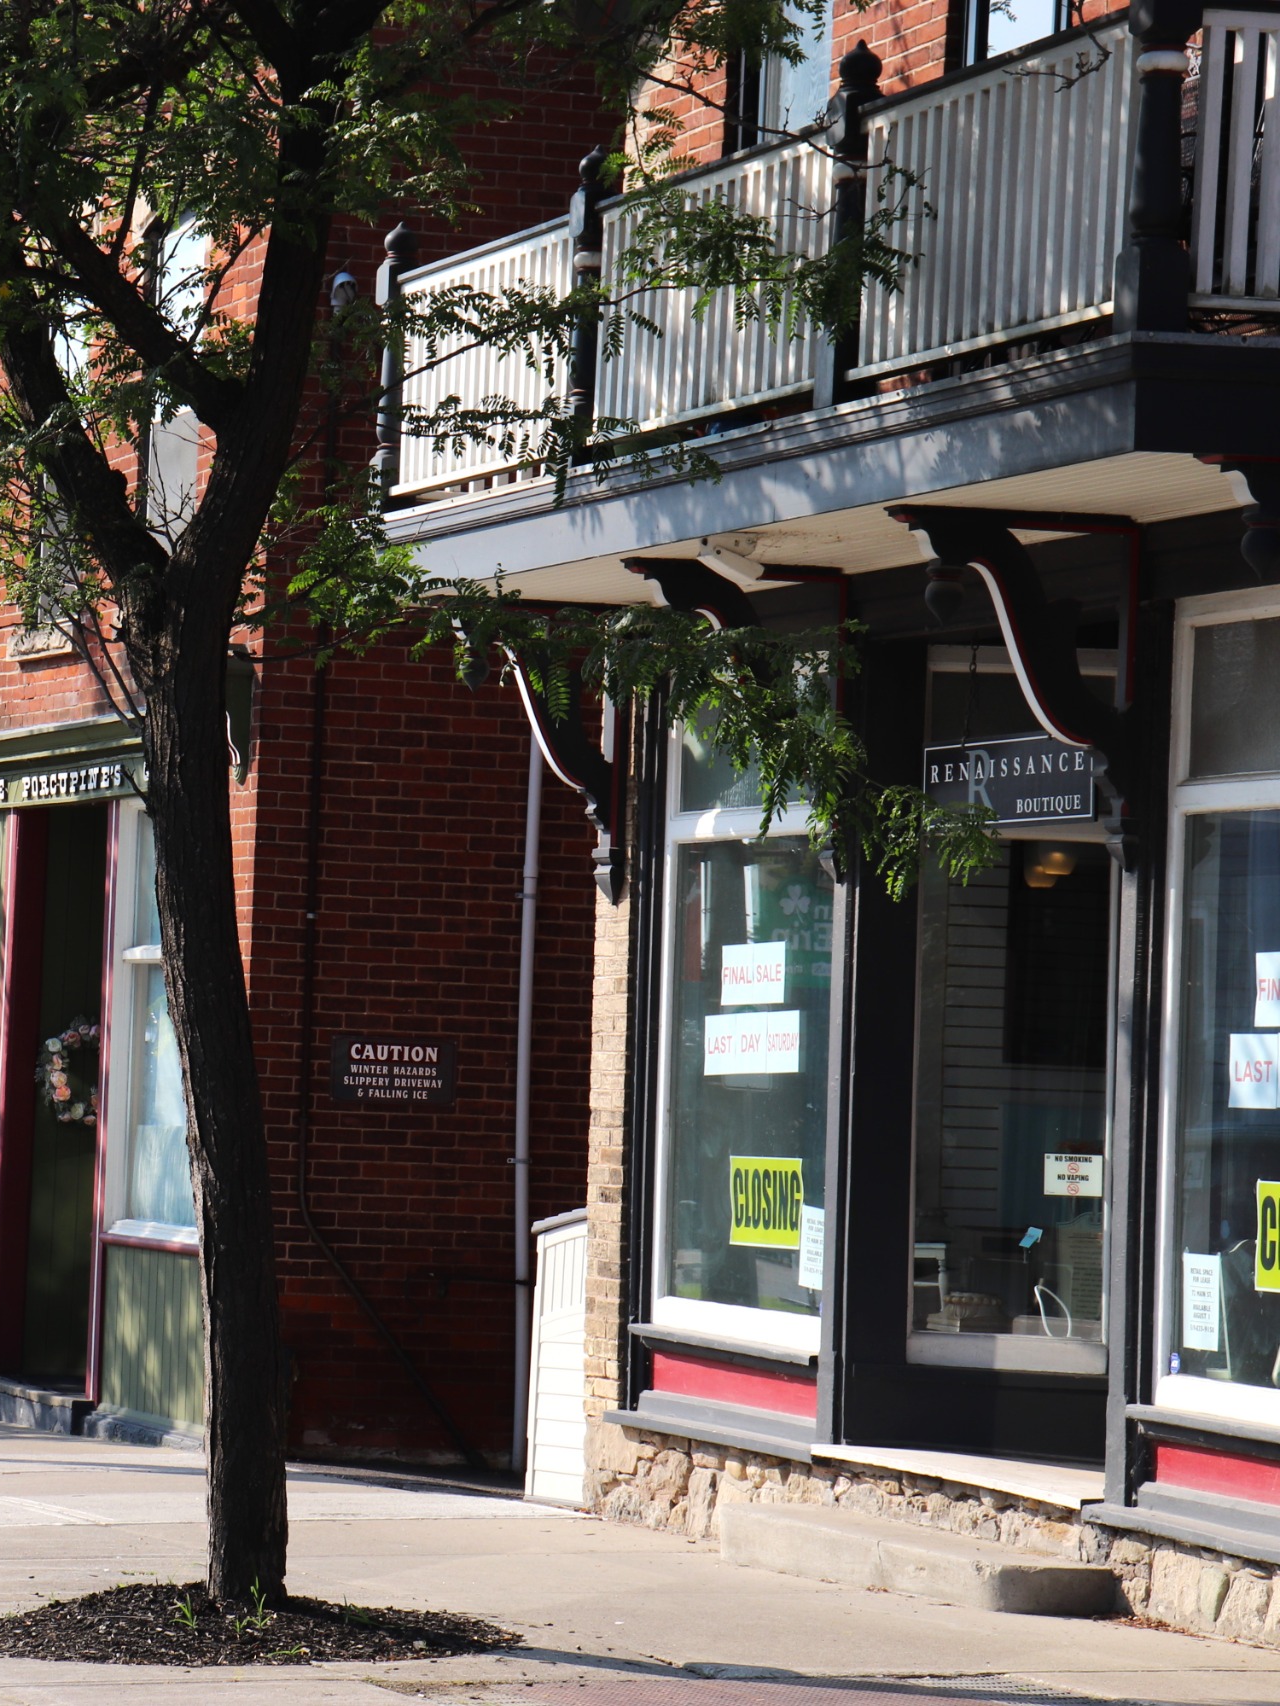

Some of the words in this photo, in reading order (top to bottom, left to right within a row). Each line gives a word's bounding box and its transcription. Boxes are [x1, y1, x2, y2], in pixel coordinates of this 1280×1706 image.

[930, 751, 1085, 784] RENAISSANCE
[21, 764, 121, 798] PORCUPINE'S
[1016, 795, 1081, 814] BOUTIQUE
[723, 966, 752, 985] FINAL
[756, 963, 782, 982] SALE
[350, 1043, 438, 1062] CAUTION
[707, 1035, 733, 1055] LAST
[740, 1033, 761, 1053] DAY
[767, 1032, 799, 1052] SATURDAY
[350, 1064, 389, 1075] WINTER
[393, 1066, 437, 1077] HAZARDS
[1235, 1061, 1273, 1083] LAST
[343, 1075, 390, 1087] SLIPPERY
[394, 1078, 443, 1089] DRIVEWAY
[357, 1088, 365, 1098] &
[368, 1088, 409, 1099] FALLING
[413, 1090, 428, 1100] ICE
[733, 1167, 801, 1232] CLOSING
